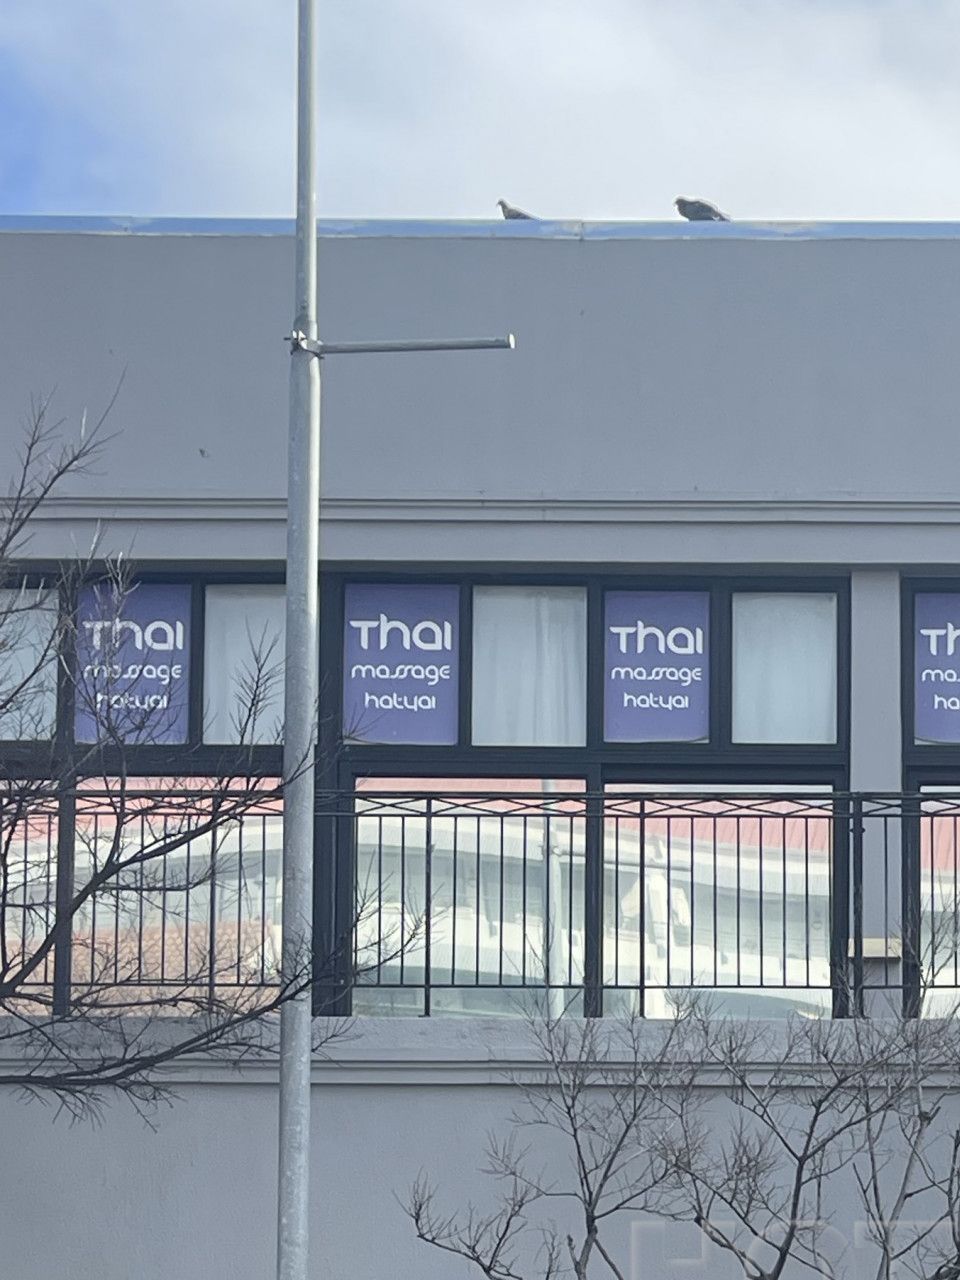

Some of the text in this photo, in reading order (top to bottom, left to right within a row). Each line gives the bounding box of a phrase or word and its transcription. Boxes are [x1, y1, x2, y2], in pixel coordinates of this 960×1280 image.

[350, 614, 451, 650] Thai
[610, 621, 703, 655] Thai
[84, 665, 181, 685] massage
[352, 665, 450, 685] massage
[611, 667, 702, 686] massage
[365, 692, 436, 711] hatyai
[624, 692, 688, 711] hatyai
